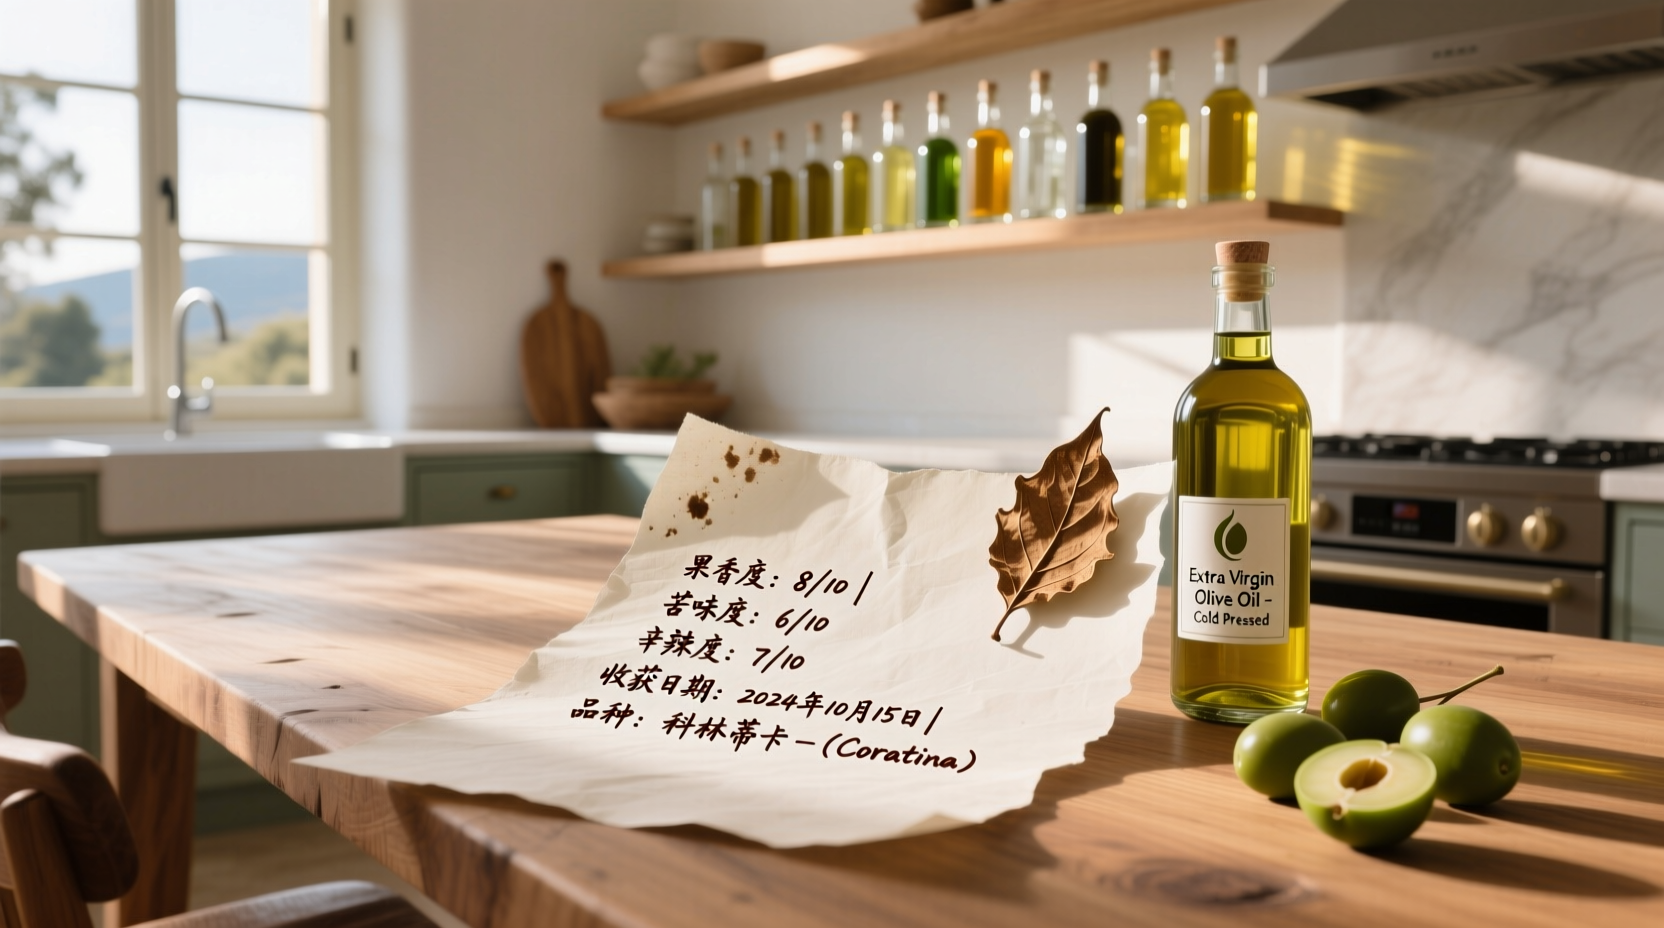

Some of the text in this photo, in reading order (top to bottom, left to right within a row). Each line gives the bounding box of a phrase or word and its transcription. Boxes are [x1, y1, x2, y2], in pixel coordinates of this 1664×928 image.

[1189, 567, 1275, 591] Extra Virgin
[1194, 588, 1234, 607] Olive
[1237, 591, 1261, 608] Oil
[1193, 610, 1270, 626] Cold Pressed
